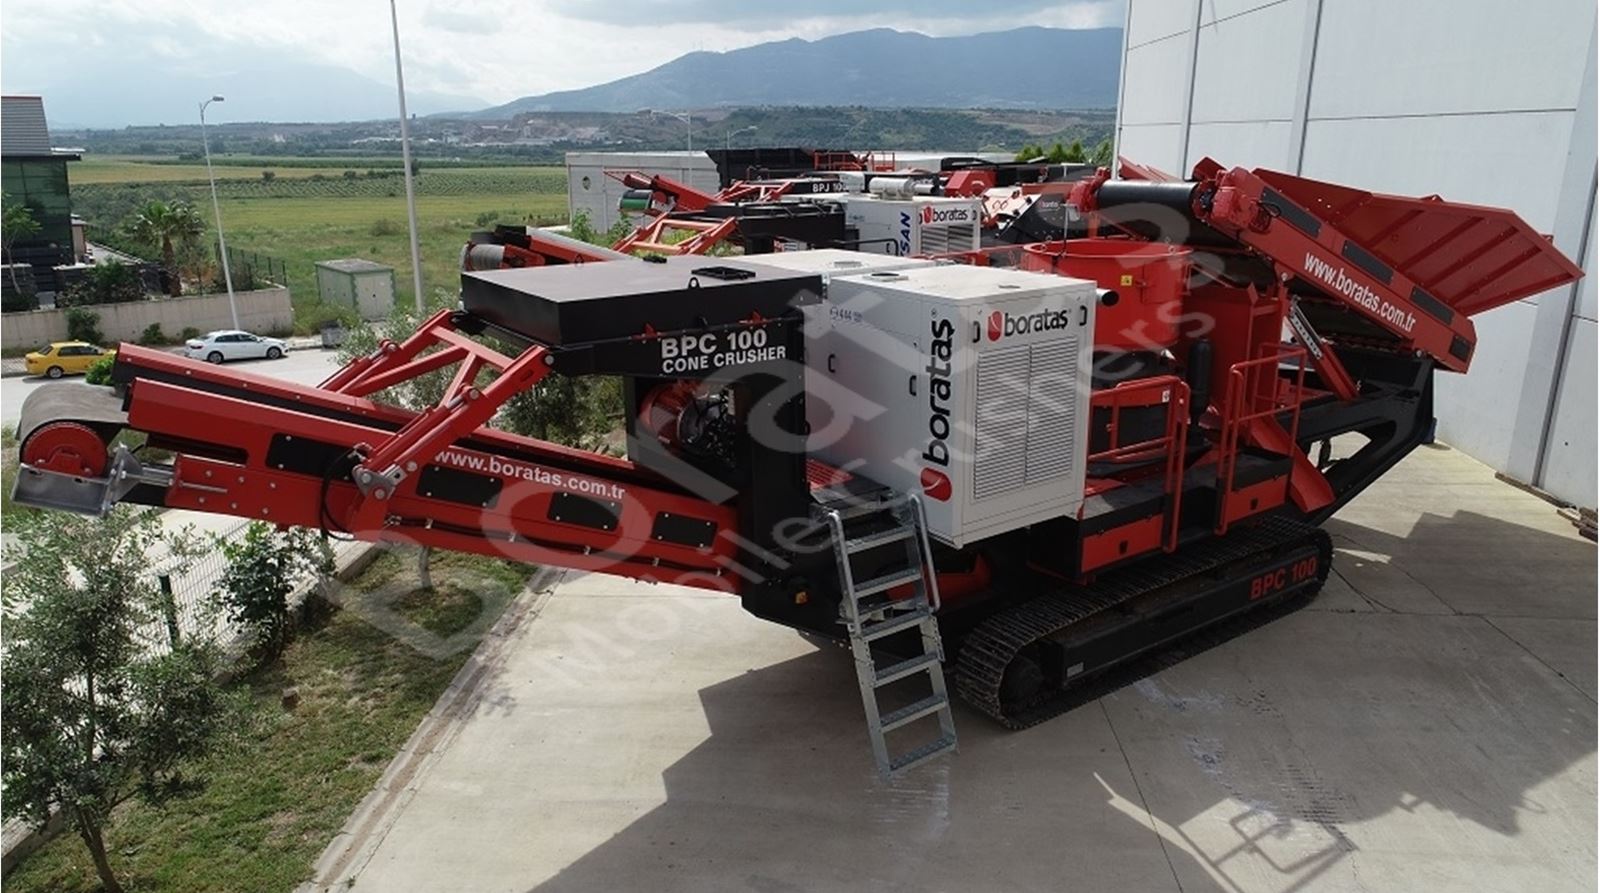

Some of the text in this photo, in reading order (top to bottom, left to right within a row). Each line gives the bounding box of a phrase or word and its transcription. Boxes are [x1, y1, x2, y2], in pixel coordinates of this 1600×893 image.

[812, 183, 830, 193] BPJ
[900, 211, 911, 257] SAN
[1304, 252, 1416, 332] www.boratas.com.tr
[661, 329, 767, 359] BPC 100
[662, 346, 786, 374] CONE CRUSHER
[434, 451, 625, 500] www.boratas.com.tr
[1250, 556, 1317, 599] BPC 100
